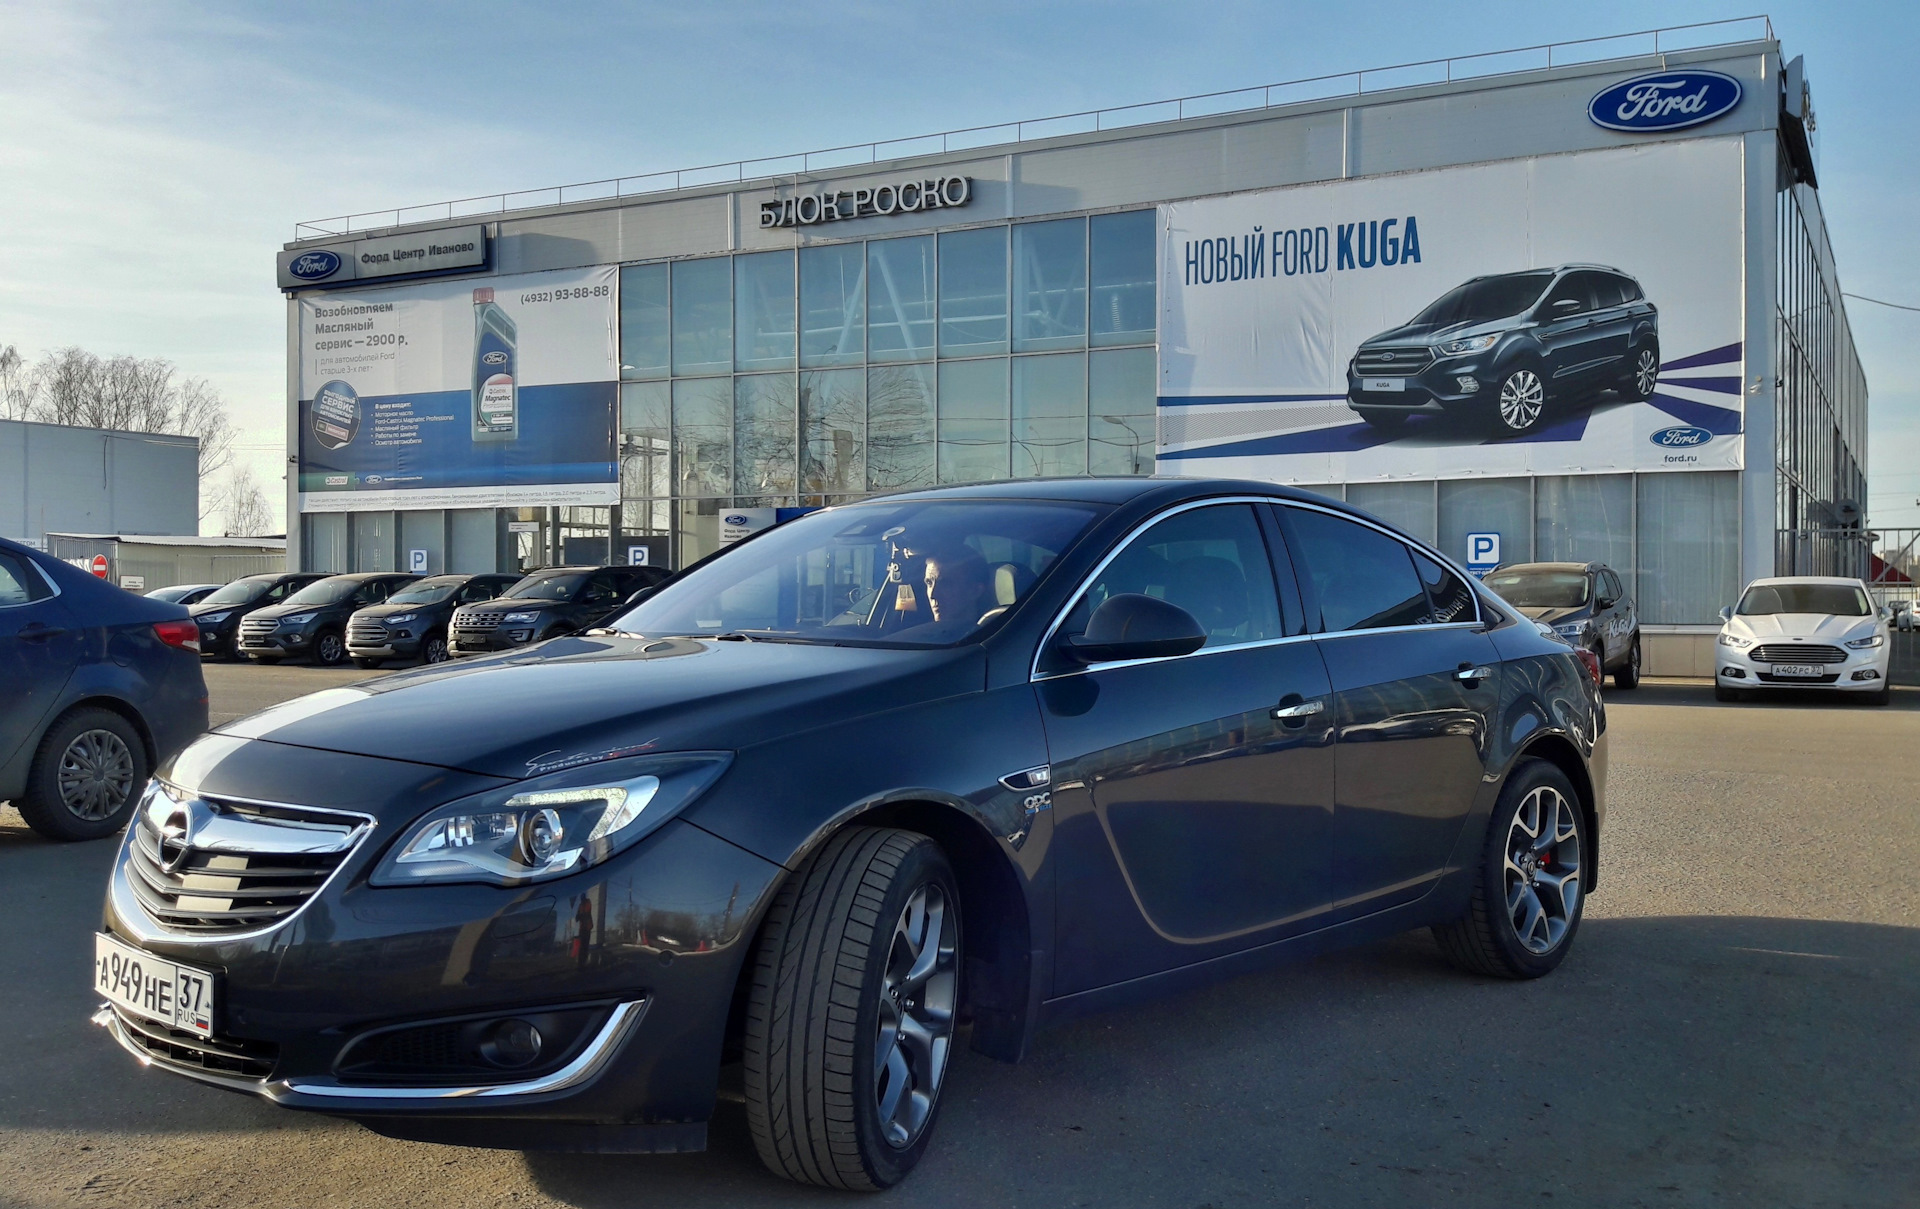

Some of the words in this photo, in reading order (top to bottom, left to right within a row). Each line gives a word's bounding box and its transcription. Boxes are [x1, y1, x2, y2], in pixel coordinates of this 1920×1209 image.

[1617, 80, 1710, 121] Ford
[759, 190, 843, 229] БЛОК
[853, 175, 970, 218] РОСКО
[361, 252, 390, 265] Форд
[393, 248, 425, 261] Центр
[428, 242, 474, 256] Иваново
[1185, 225, 1265, 286] НОВЫЙ
[1272, 226, 1329, 277] FORD
[1337, 216, 1421, 271] KUGA
[297, 254, 328, 274] Ford
[520, 291, 553, 305] (4932)
[554, 285, 609, 300] 93-88-88
[315, 303, 394, 318] Возобновляем
[315, 317, 374, 334] Масляный
[315, 339, 353, 351] сервис
[366, 333, 396, 347] 2900
[398, 335, 408, 347] р.
[320, 357, 334, 366] для
[335, 353, 379, 364] автомобилей
[380, 352, 395, 360] Ford
[321, 395, 354, 413] СЕРВИС
[485, 395, 511, 403] Magnatec
[1662, 429, 1701, 445] Ford
[1664, 454, 1697, 463] ford.ru
[1474, 537, 1494, 561] P
[413, 551, 424, 569] P
[179, 973, 203, 1012] 37
[177, 1008, 196, 1025] RUS
